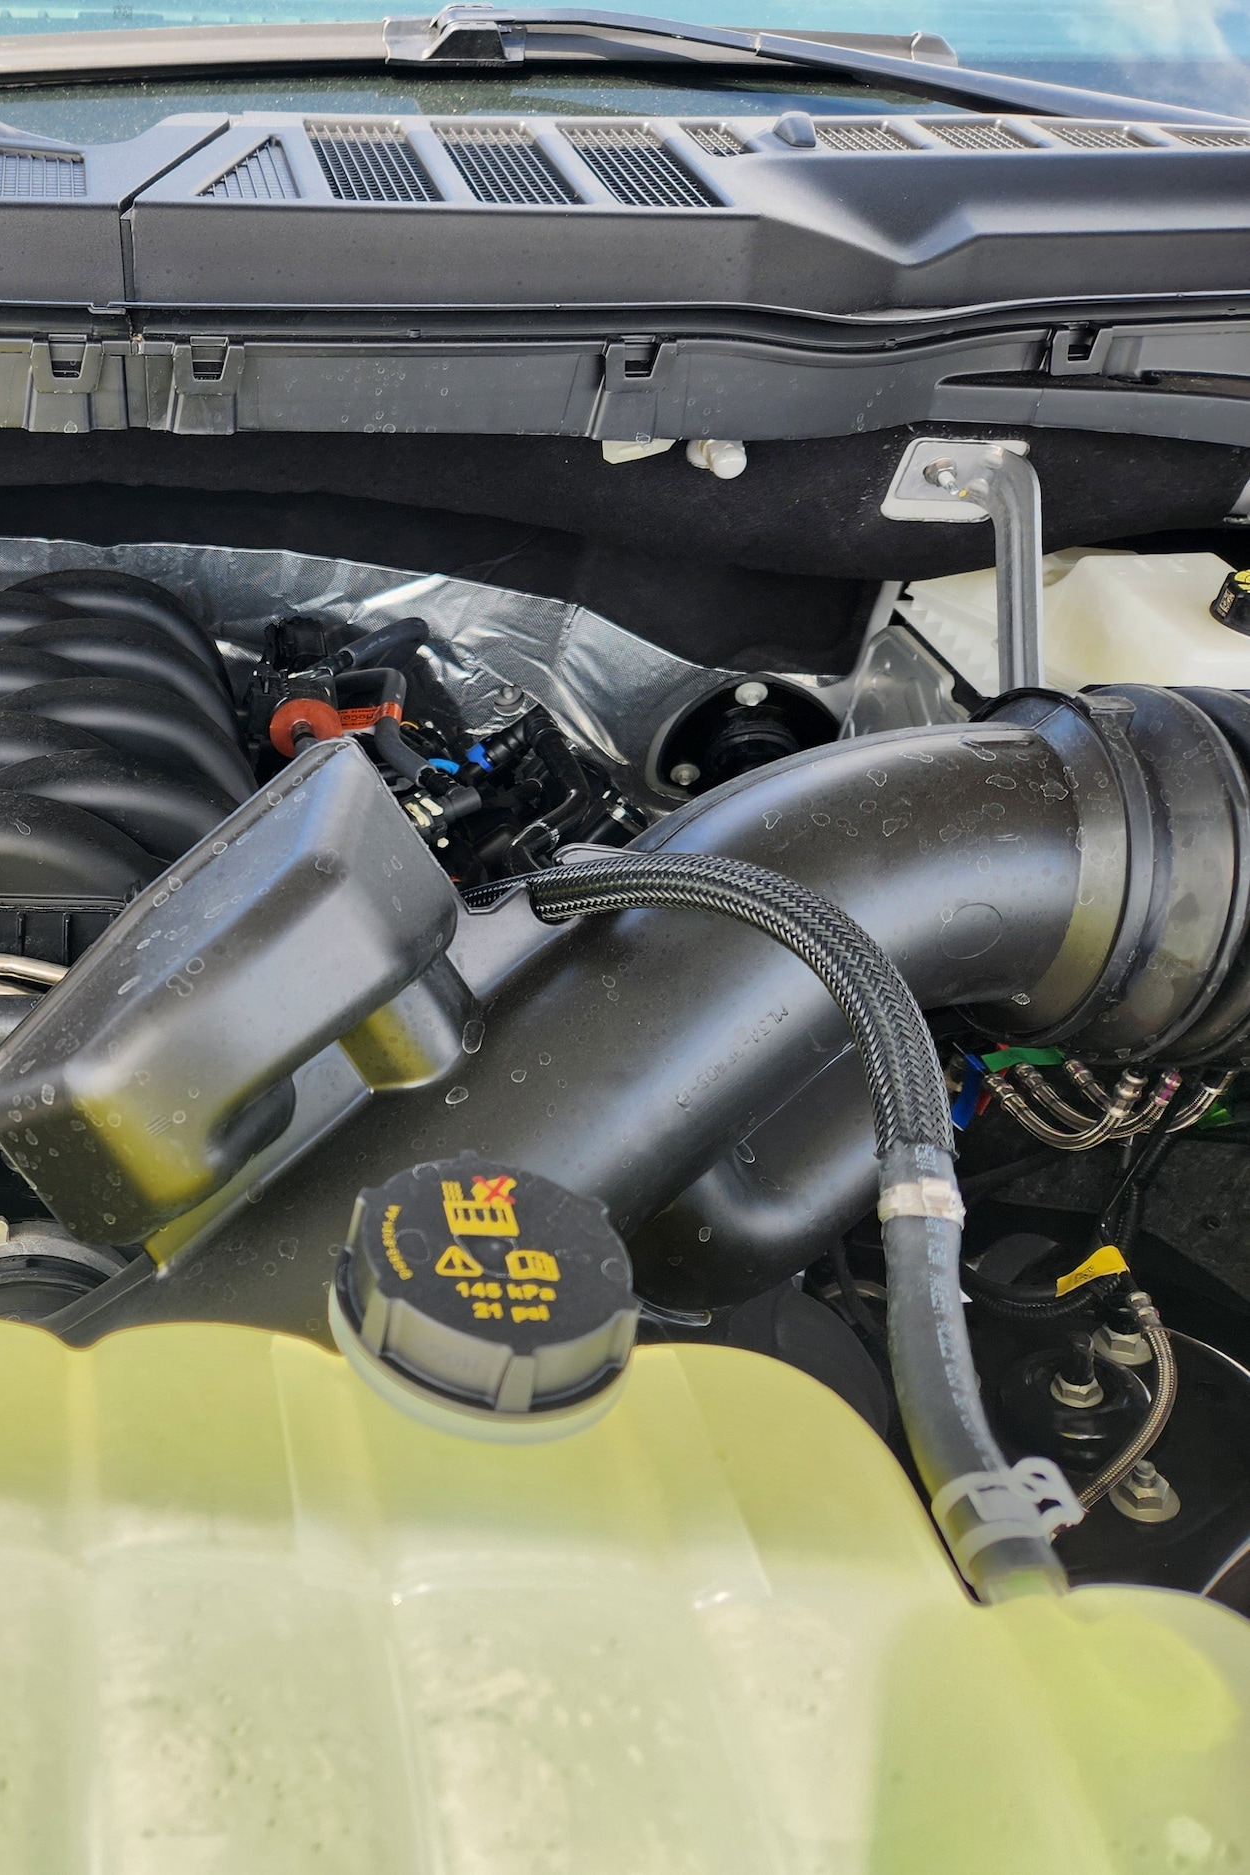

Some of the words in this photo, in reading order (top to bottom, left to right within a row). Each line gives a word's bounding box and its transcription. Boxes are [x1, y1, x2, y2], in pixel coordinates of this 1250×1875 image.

[455, 1281, 503, 1300] 145
[507, 1283, 557, 1301] kPa
[472, 1301, 504, 1319] 21
[511, 1304, 551, 1323] psi
